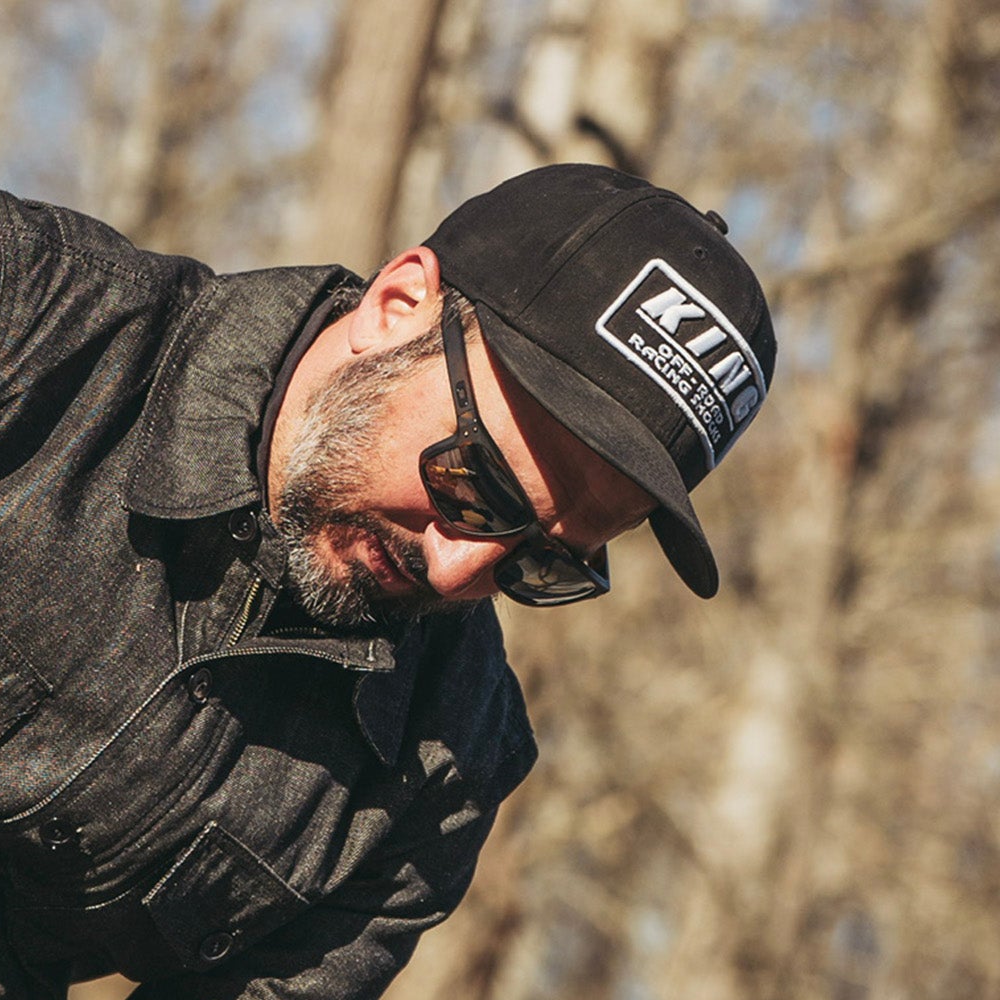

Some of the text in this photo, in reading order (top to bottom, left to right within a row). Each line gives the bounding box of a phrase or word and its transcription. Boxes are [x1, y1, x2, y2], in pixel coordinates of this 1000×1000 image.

[628, 332, 721, 443] RACING SHOCKS
[640, 286, 759, 424] KING
[658, 343, 724, 423] OFF-ROAD
